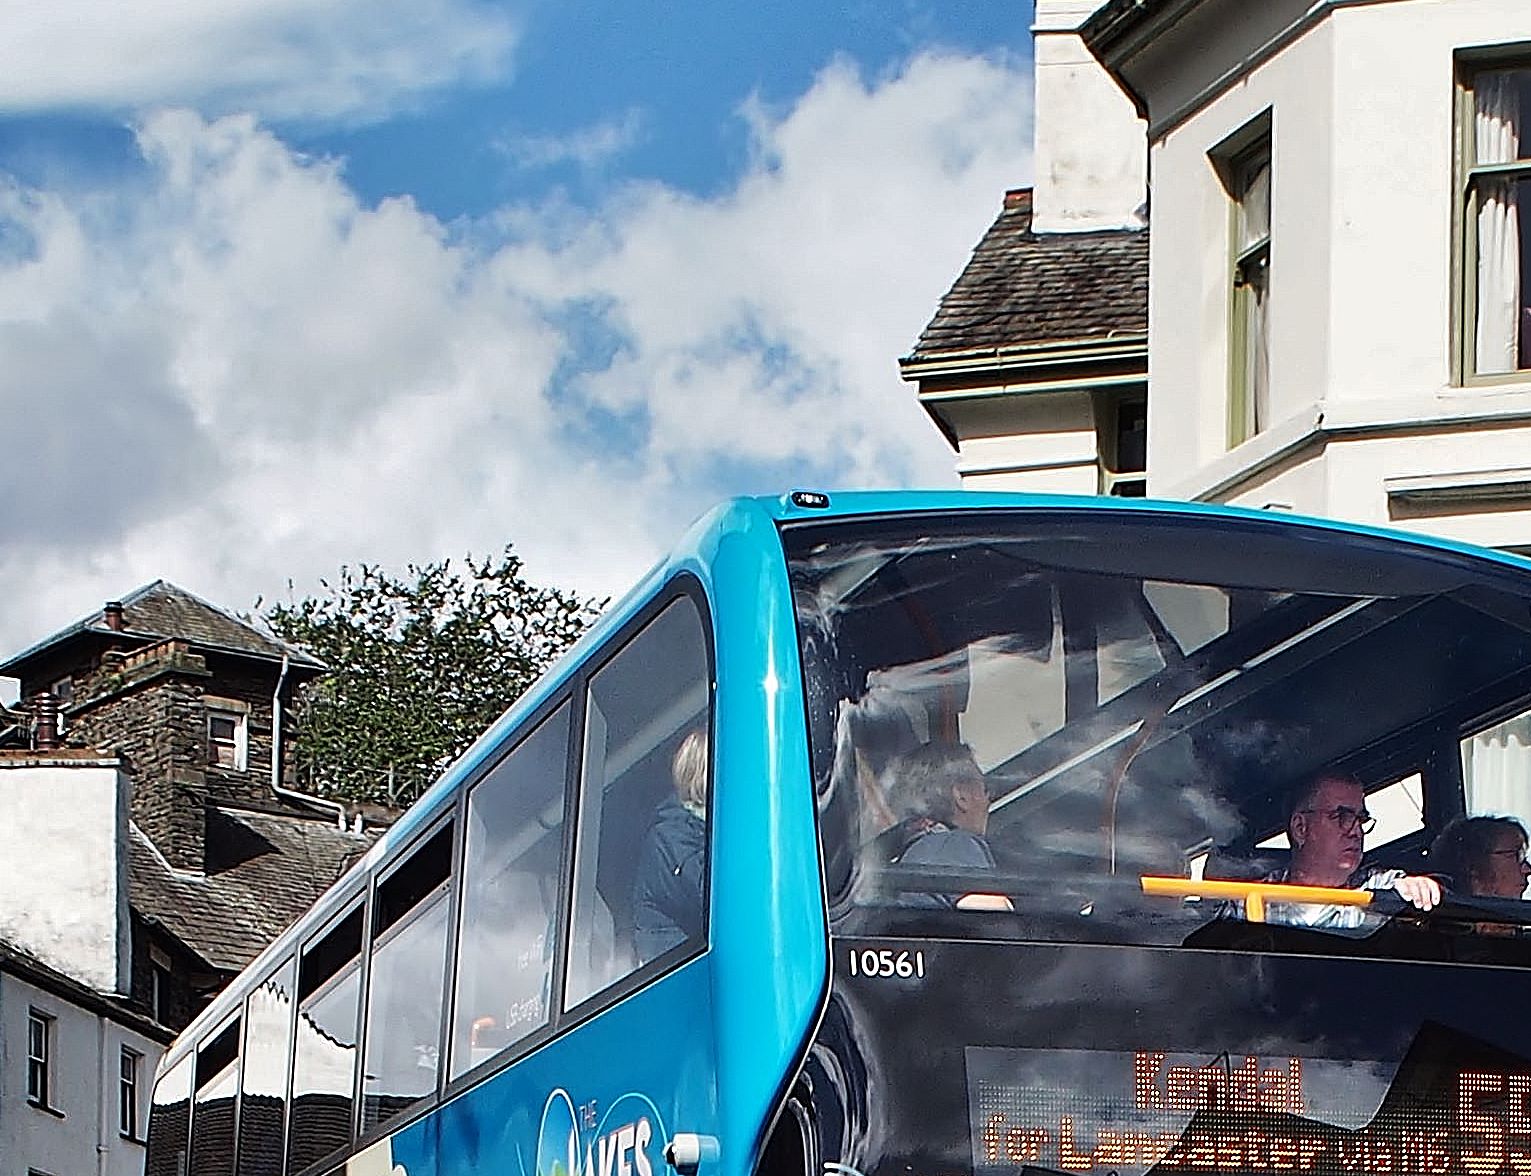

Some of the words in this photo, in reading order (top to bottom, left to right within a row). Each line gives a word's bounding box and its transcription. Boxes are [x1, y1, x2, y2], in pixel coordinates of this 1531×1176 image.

[850, 949, 924, 978] 10561
[1135, 1051, 1304, 1114] Kendal
[579, 1099, 597, 1131] THE
[983, 1114, 1048, 1162] for
[1061, 1115, 1327, 1170] Lancaster
